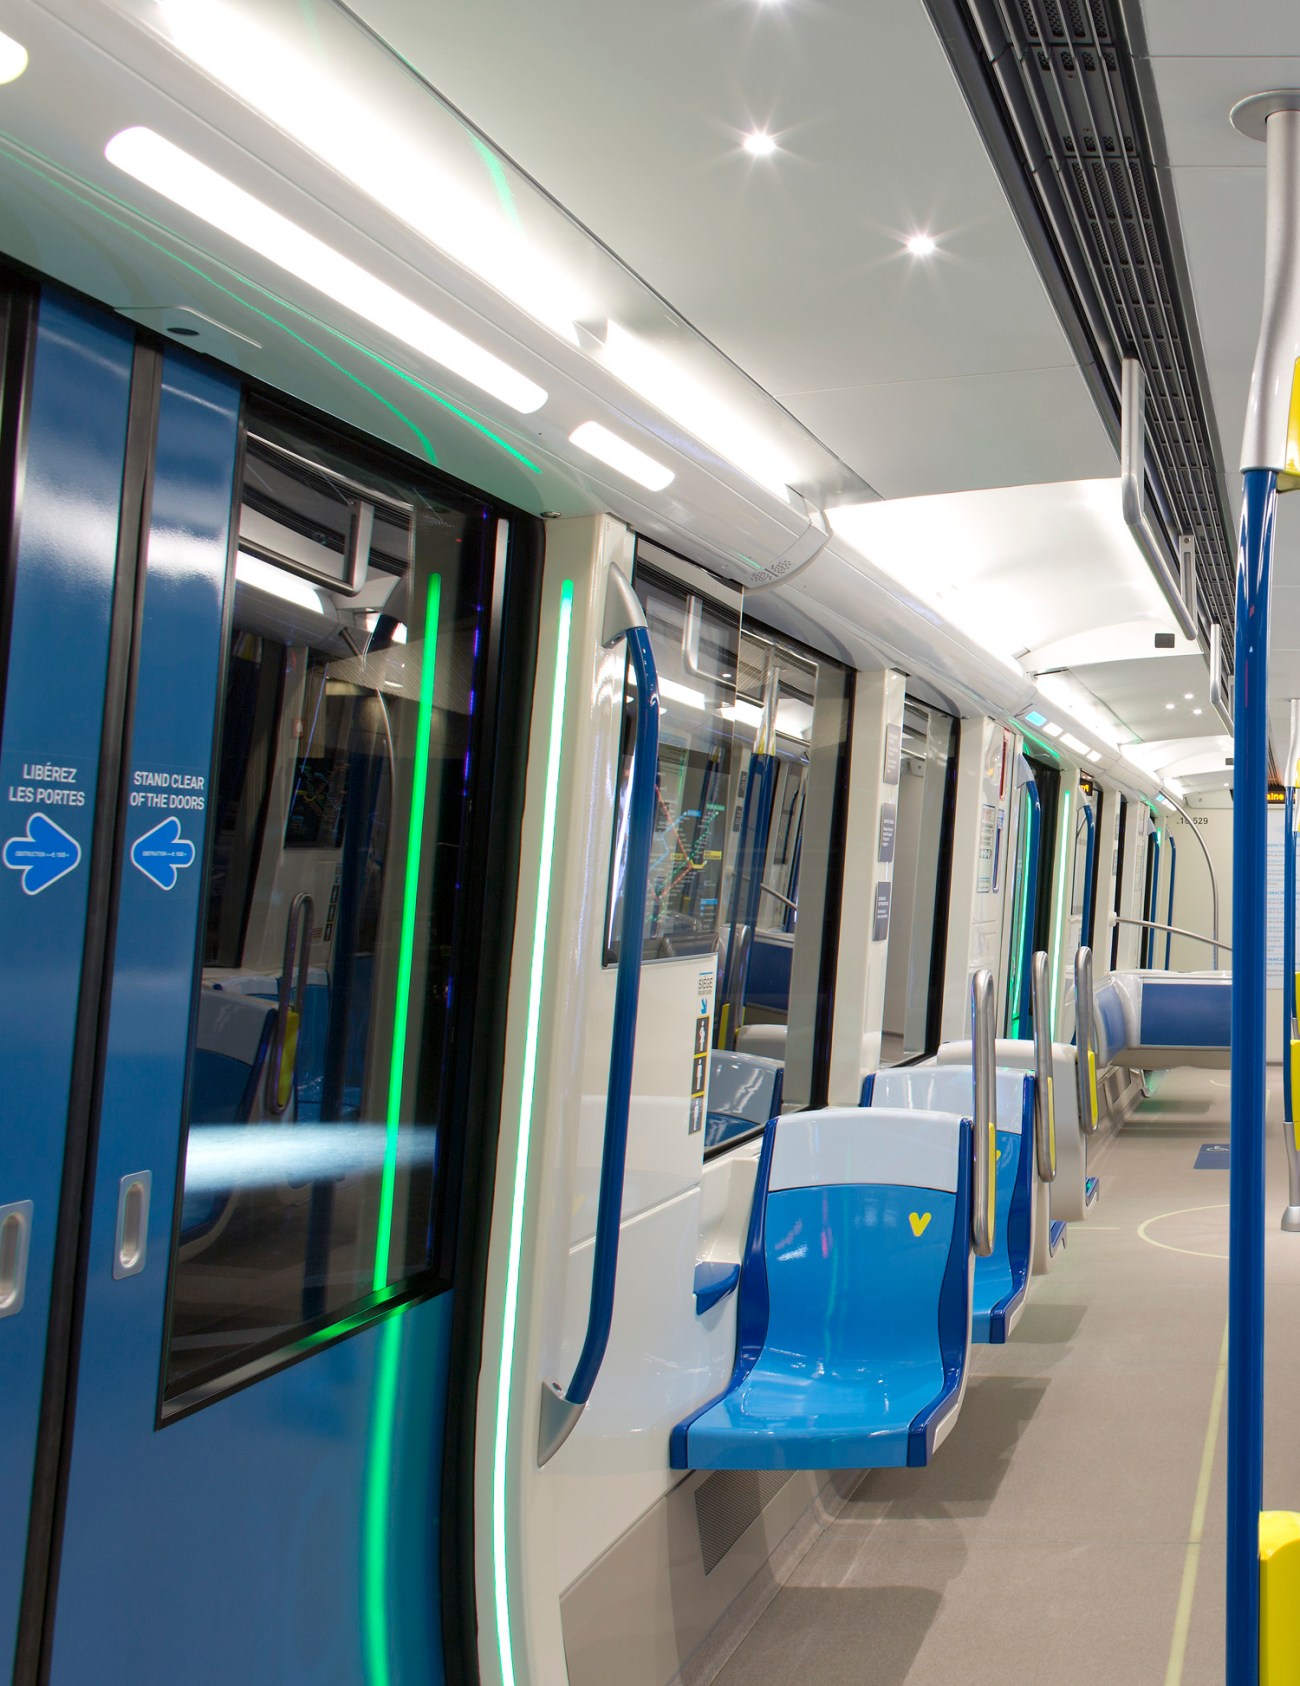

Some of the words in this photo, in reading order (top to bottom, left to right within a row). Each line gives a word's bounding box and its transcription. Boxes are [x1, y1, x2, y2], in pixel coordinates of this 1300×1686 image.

[23, 762, 77, 783] LIBÉREZ
[134, 771, 170, 787] STAND
[171, 774, 205, 790] CLEAR
[9, 786, 34, 803] LES
[36, 788, 85, 806] PORTES
[130, 792, 145, 806] OF
[146, 793, 168, 808] THE
[169, 795, 205, 810] DOORS
[698, 976, 712, 990] SIÈGE
